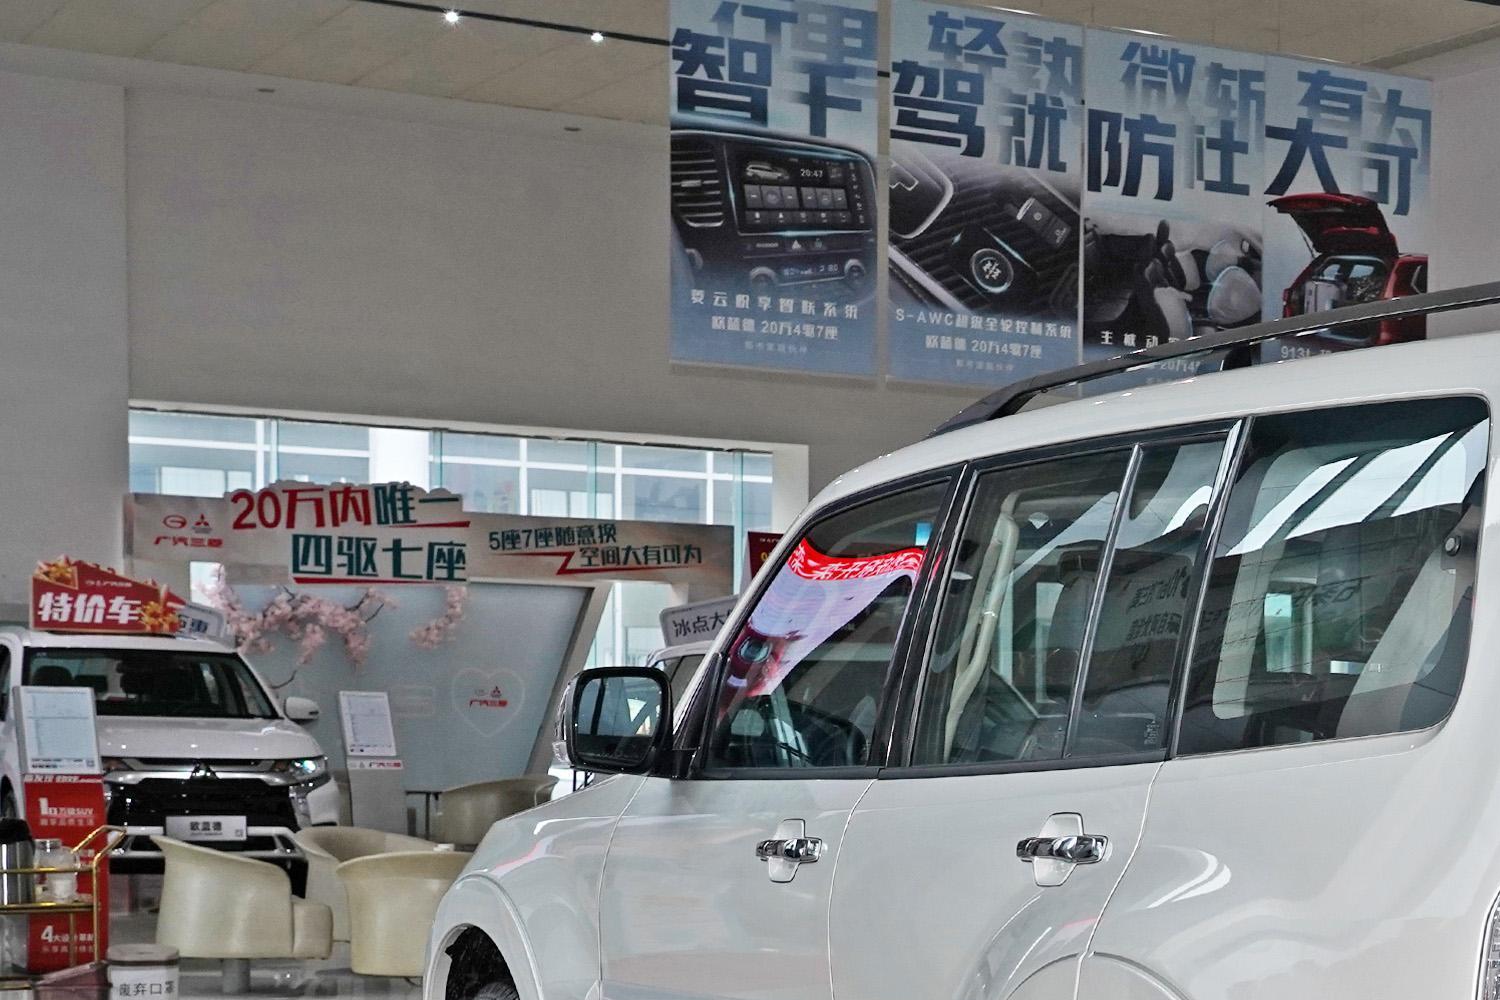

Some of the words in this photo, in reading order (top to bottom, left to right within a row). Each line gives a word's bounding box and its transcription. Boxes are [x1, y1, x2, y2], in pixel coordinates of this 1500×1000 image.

[231, 486, 460, 530] 20万内唯一
[153, 535, 224, 548] 广汽三菱
[292, 534, 466, 581] 四驱七座
[579, 545, 703, 567] 空间大有可为
[38, 592, 142, 624] 特价车
[672, 609, 731, 637] 冰点大
[118, 980, 176, 997] 废弃口罩
